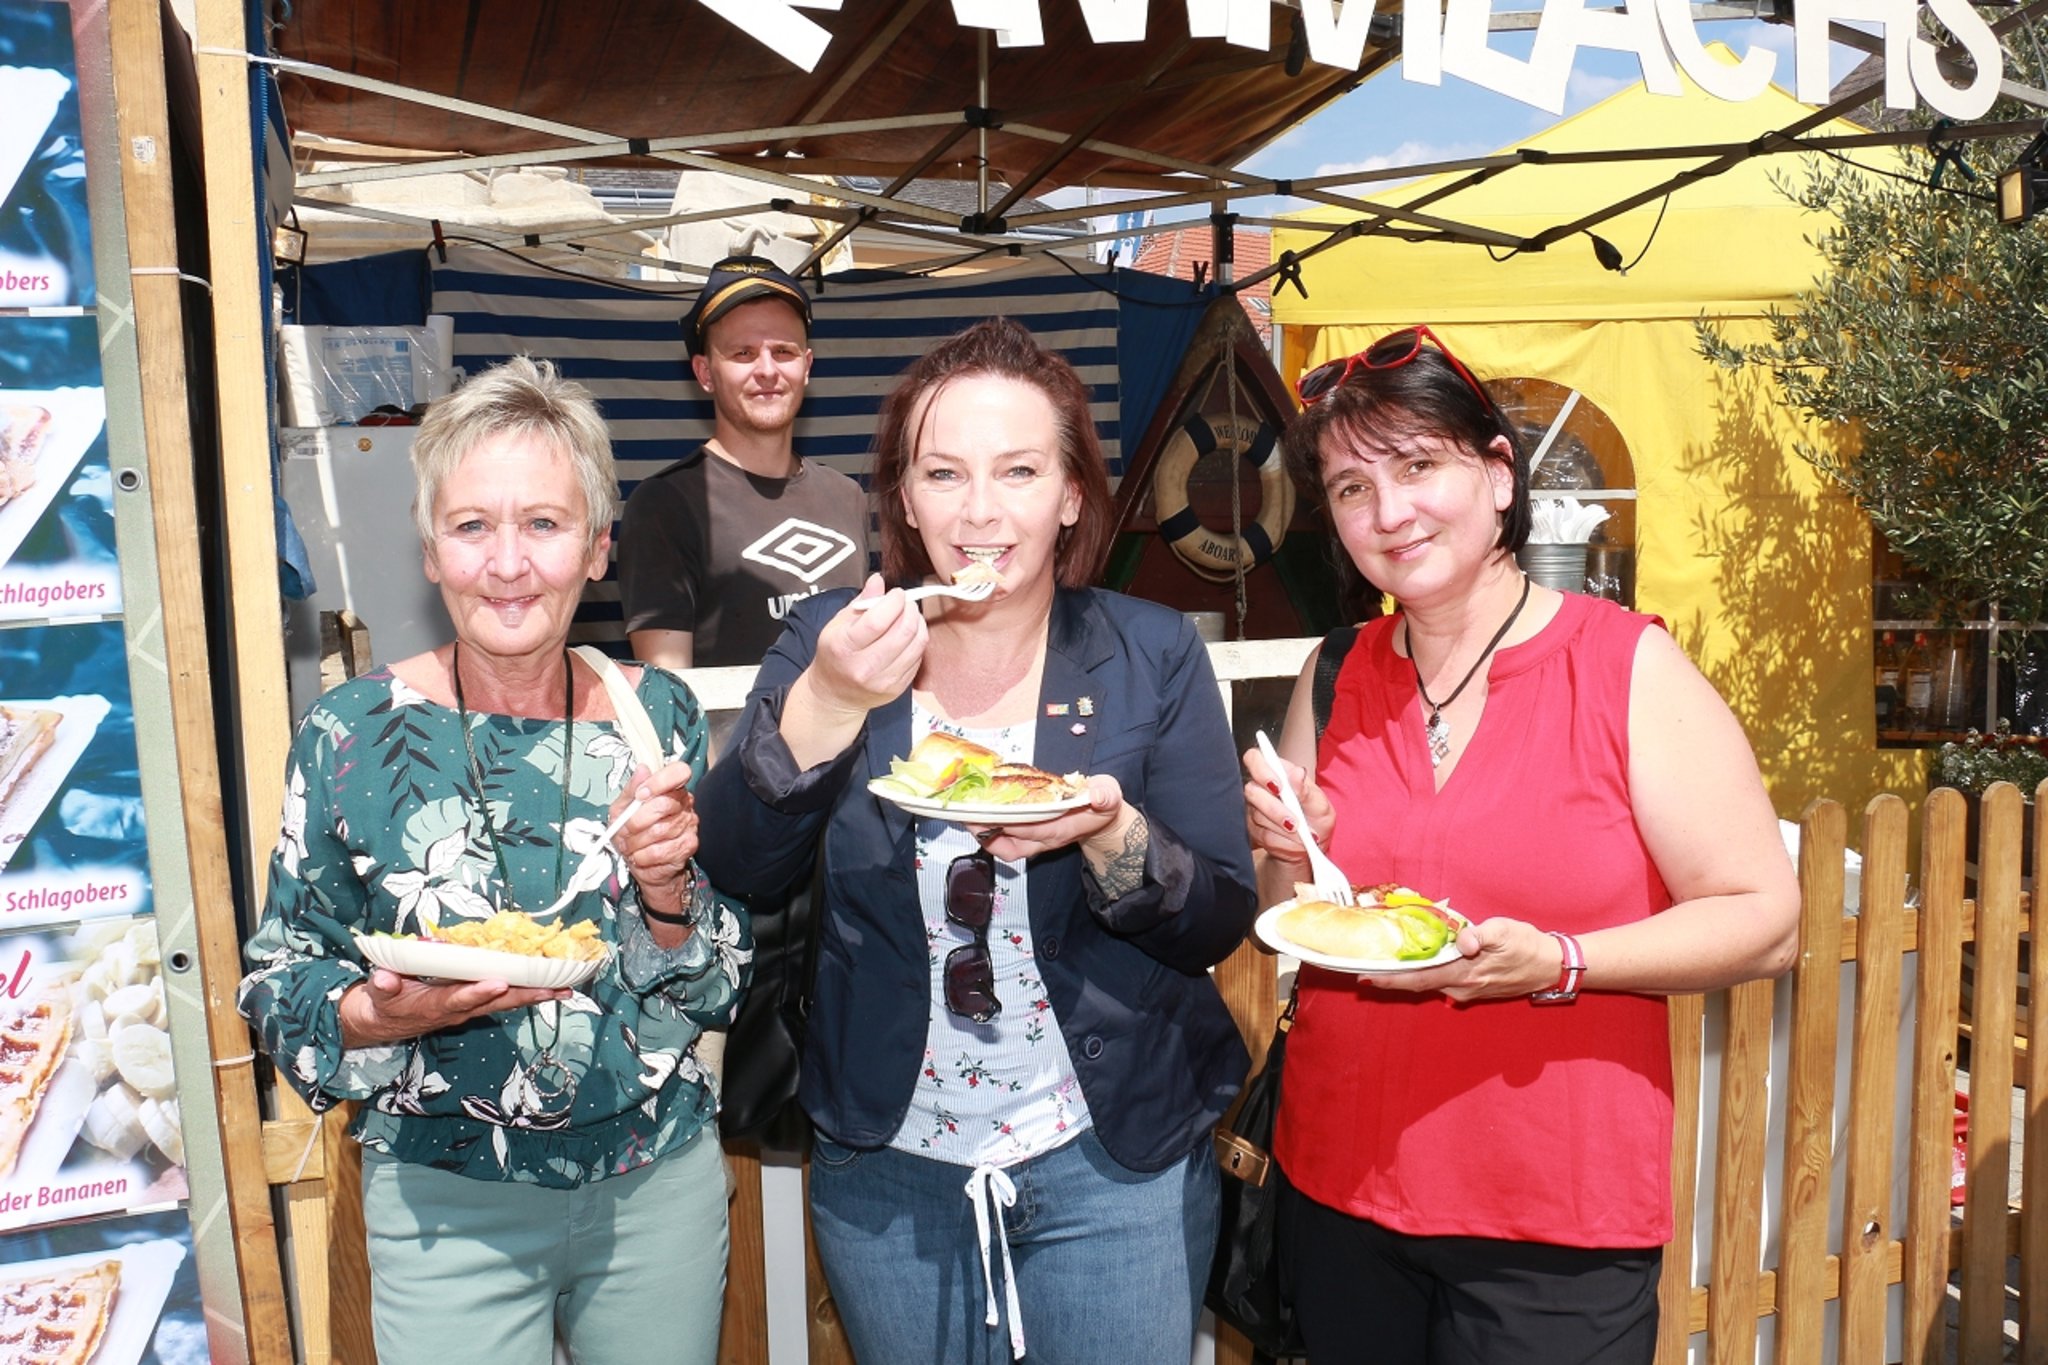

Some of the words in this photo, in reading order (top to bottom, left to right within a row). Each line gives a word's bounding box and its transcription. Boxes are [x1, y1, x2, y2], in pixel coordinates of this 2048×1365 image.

[1198, 539, 1244, 564] ABOAR
[6, 882, 127, 912] Schlagobers
[0, 1191, 33, 1213] der
[37, 1178, 127, 1207] Bananen
